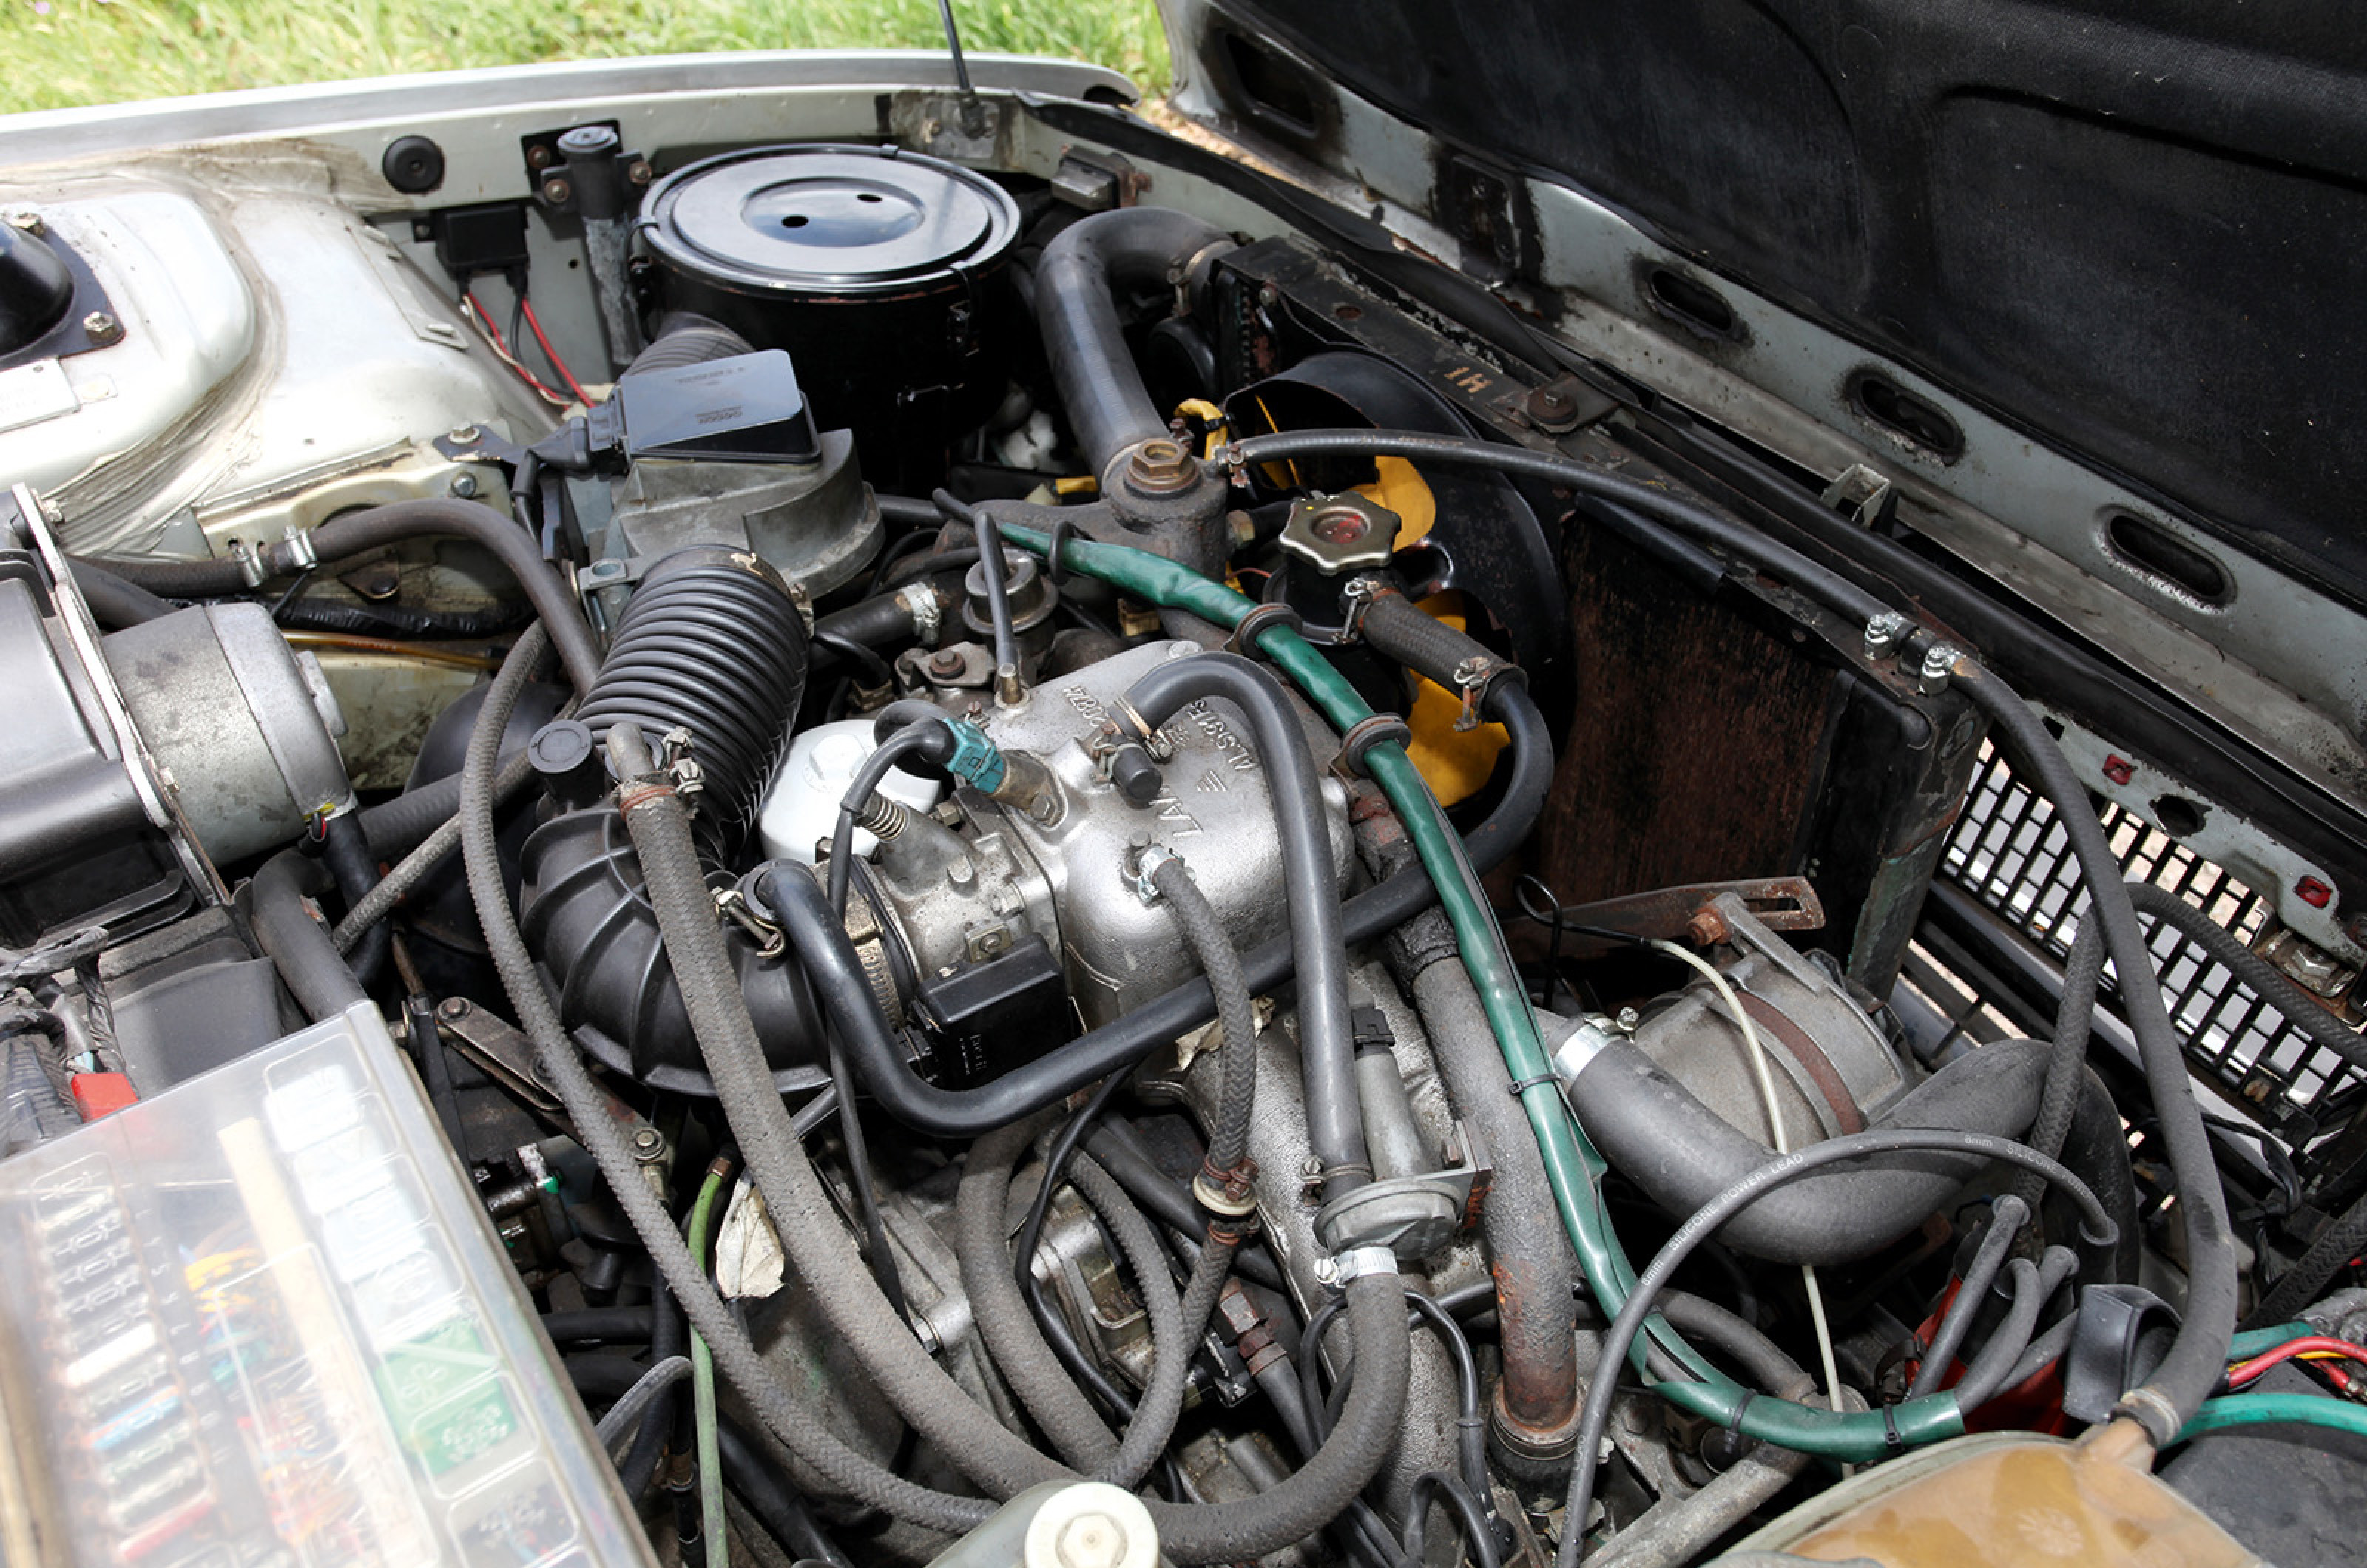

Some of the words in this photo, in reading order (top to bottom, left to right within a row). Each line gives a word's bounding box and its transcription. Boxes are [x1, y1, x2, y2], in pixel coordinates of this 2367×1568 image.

[1668, 1203, 1718, 1251] SILICONE
[1720, 1171, 1766, 1203] POWER
[1769, 1153, 1804, 1175] LEAD
